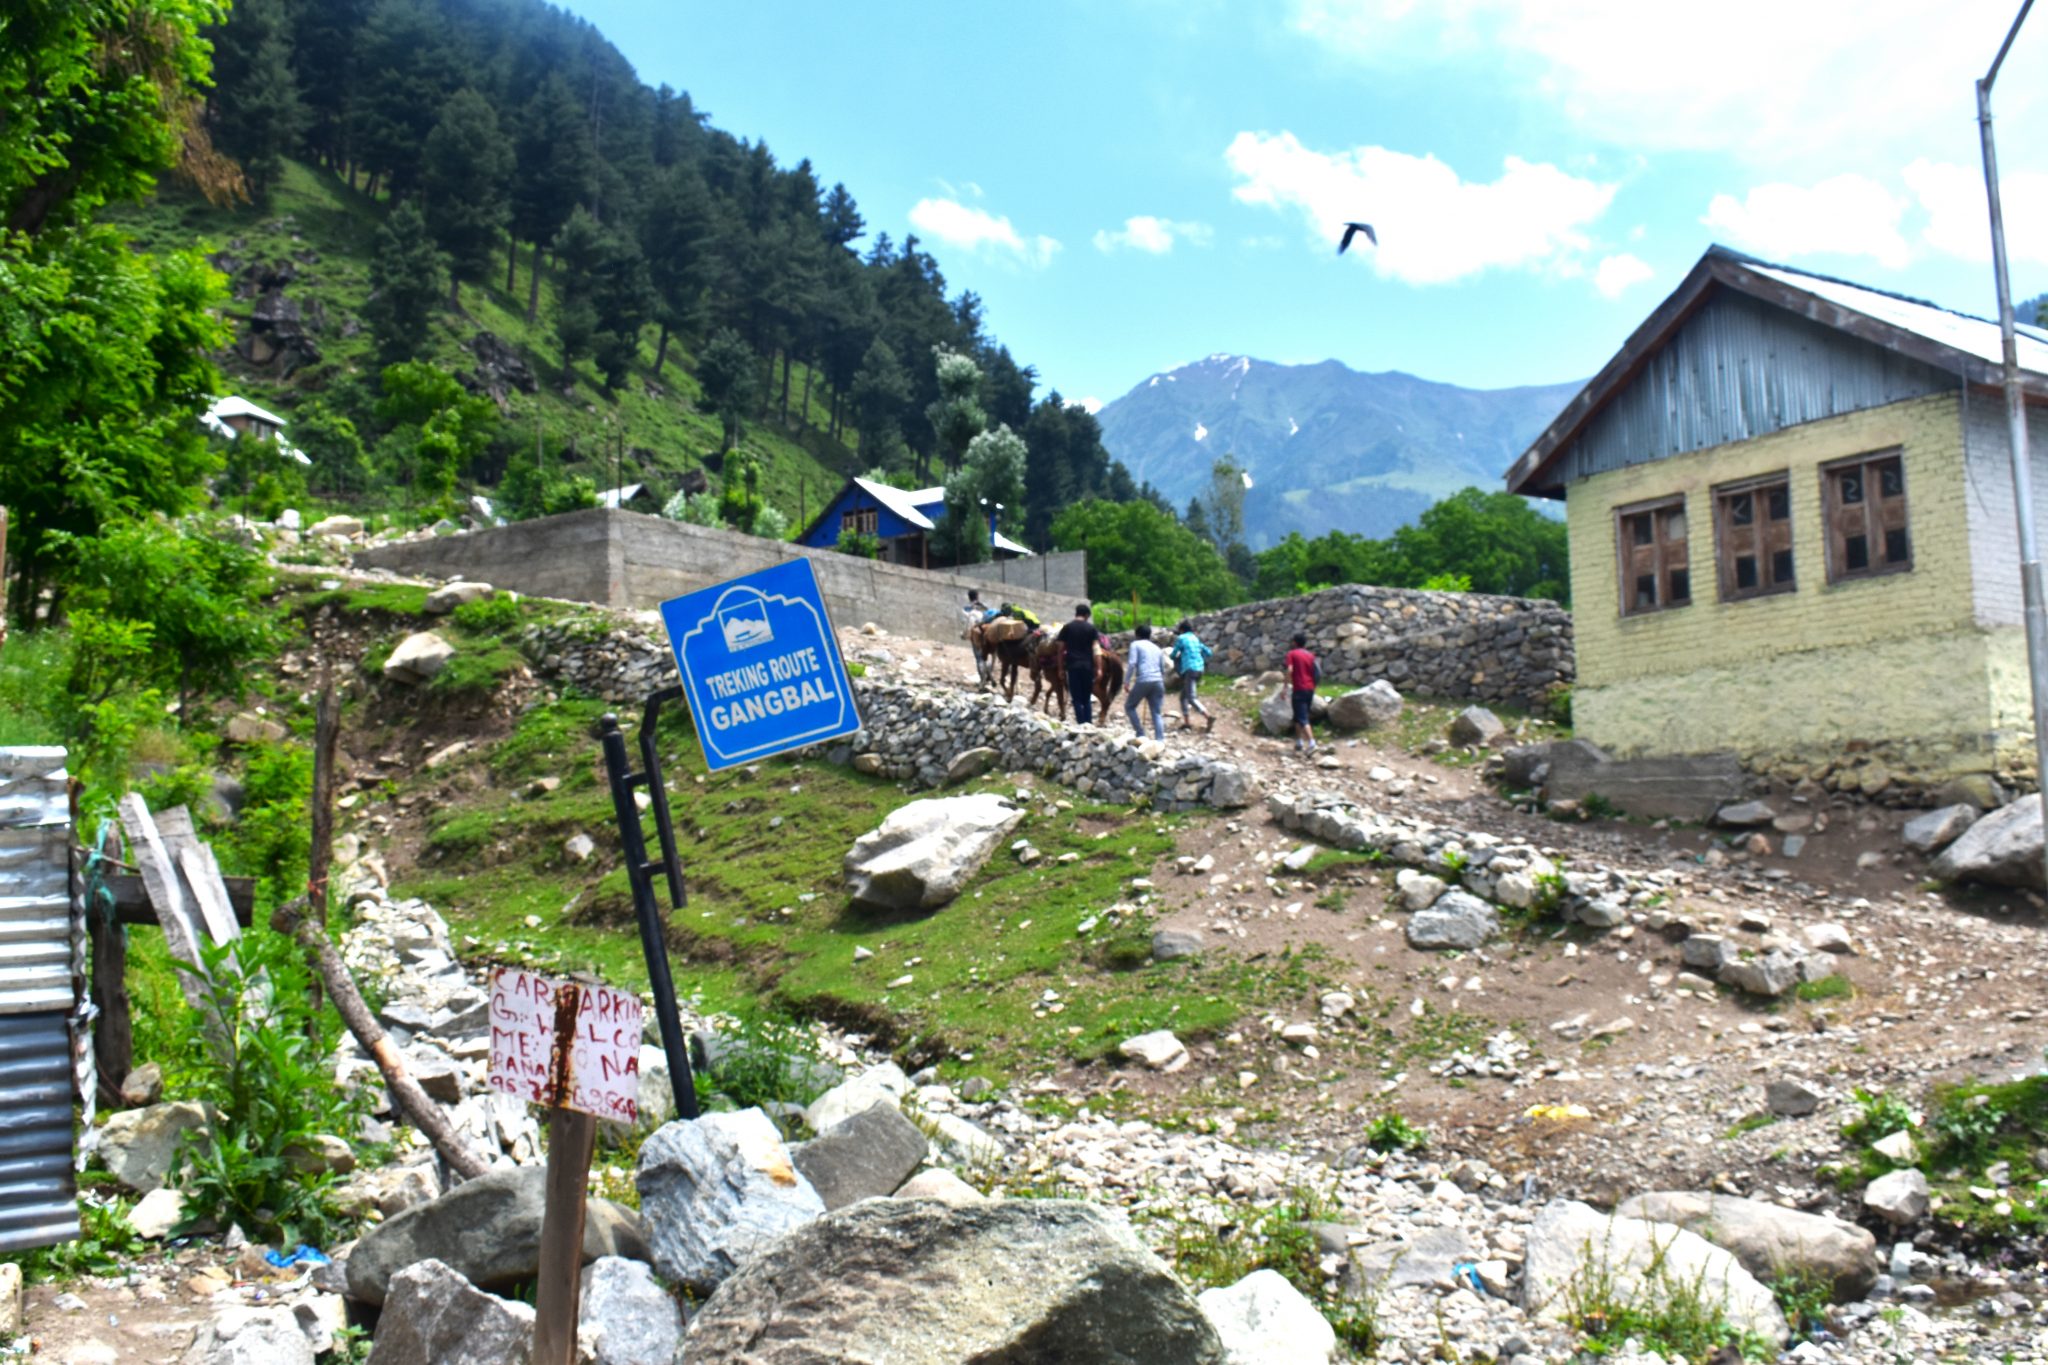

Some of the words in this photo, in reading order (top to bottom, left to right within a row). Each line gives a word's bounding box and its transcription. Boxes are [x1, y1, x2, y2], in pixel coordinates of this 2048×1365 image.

[705, 662, 770, 700] TREKING
[769, 647, 820, 682] ROUTE
[710, 677, 835, 731] GANGBAL
[495, 967, 550, 1007] CAR
